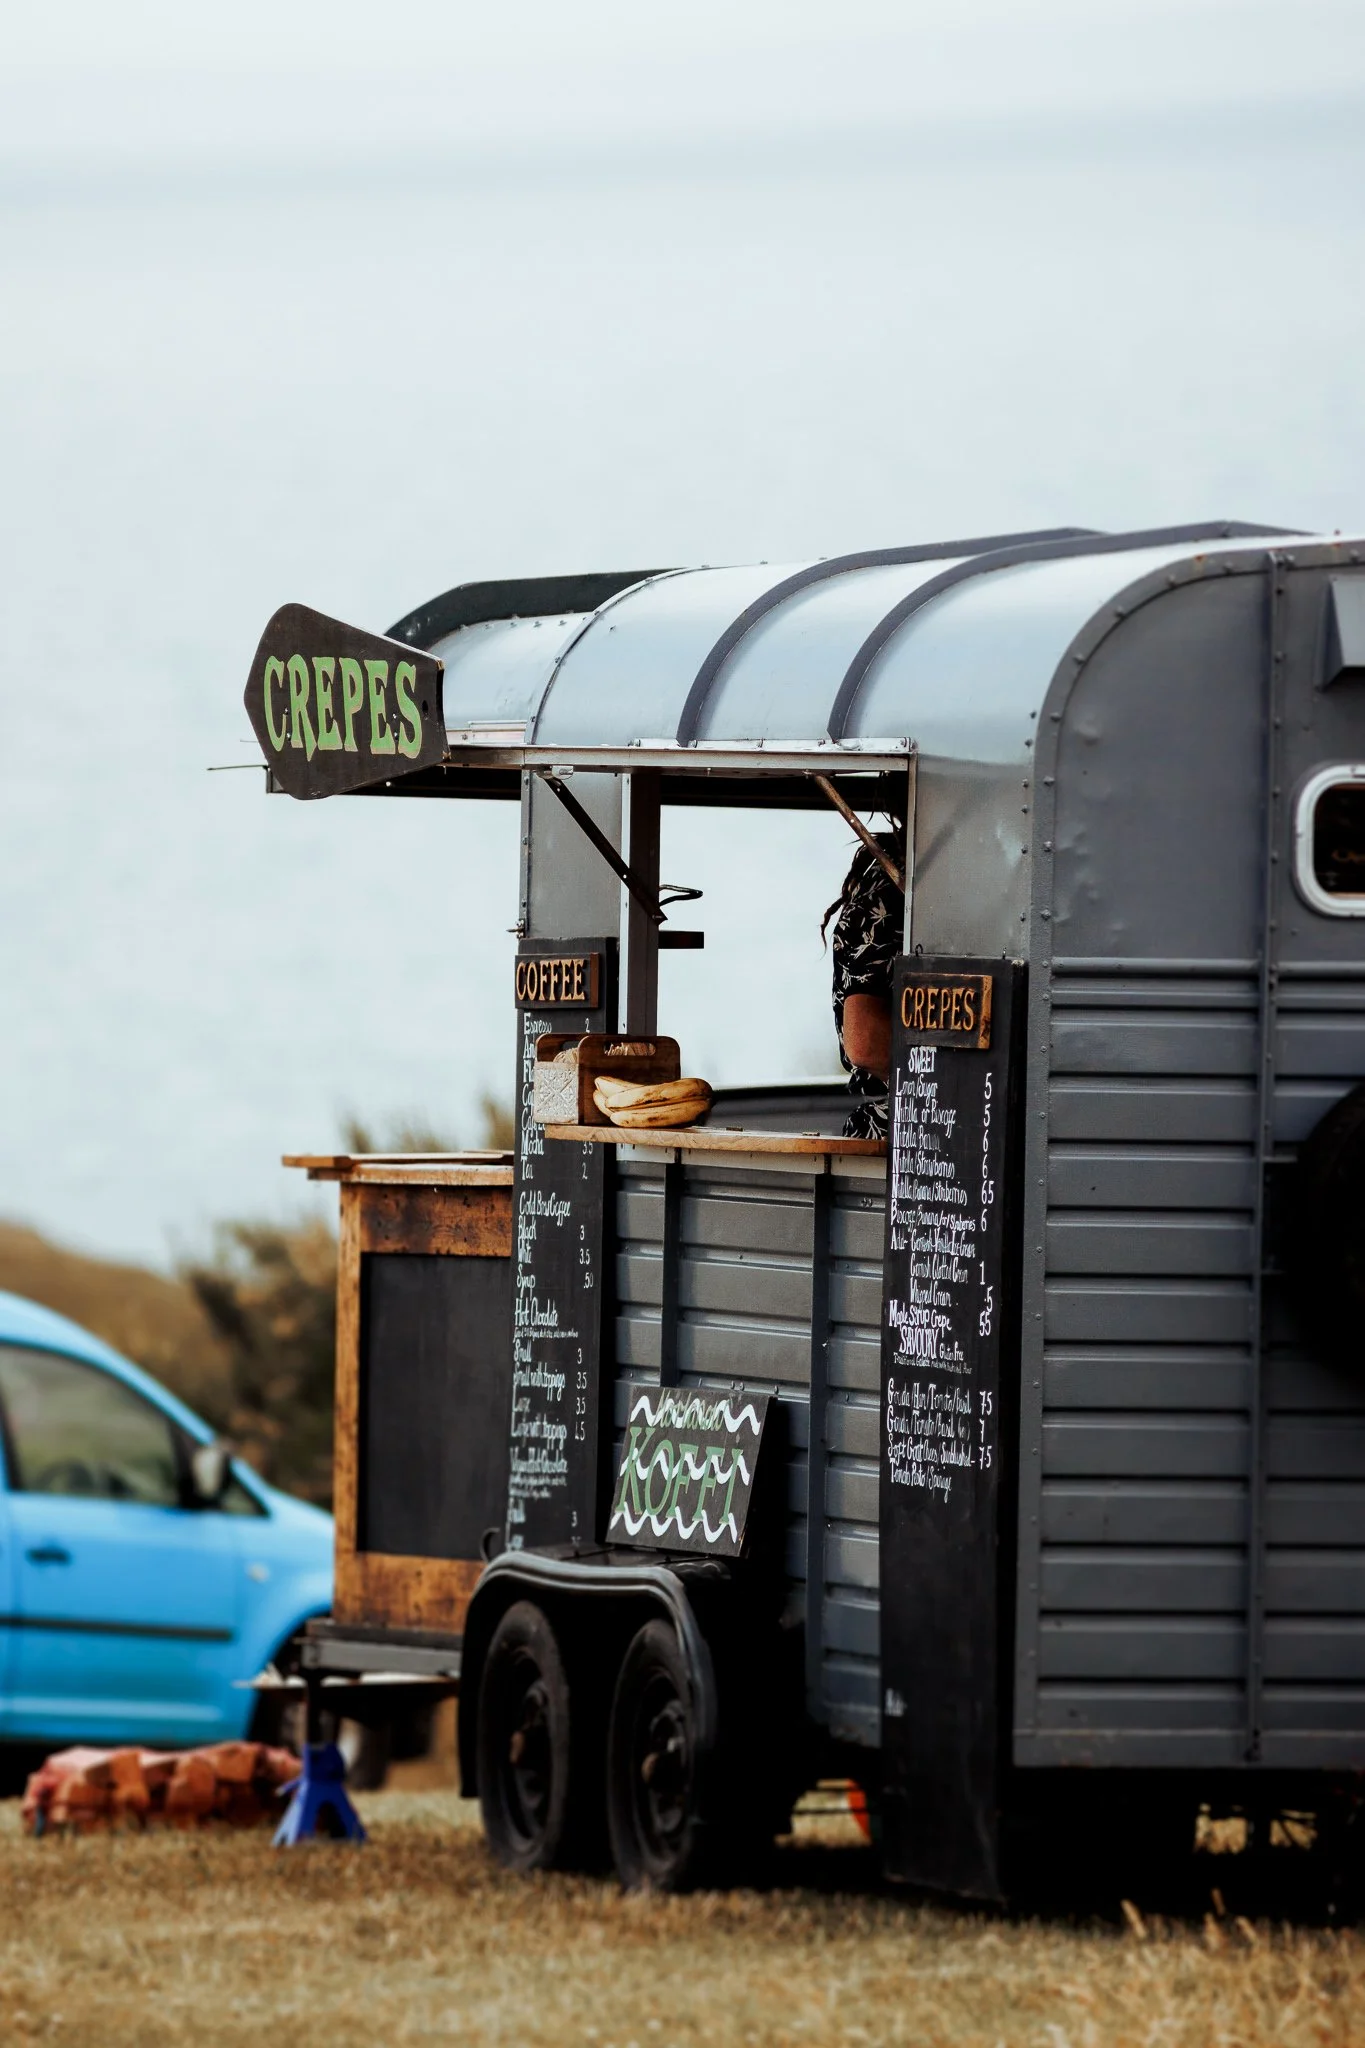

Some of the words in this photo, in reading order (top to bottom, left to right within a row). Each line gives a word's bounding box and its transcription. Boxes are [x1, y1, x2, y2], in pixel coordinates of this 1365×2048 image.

[263, 654, 423, 762] CREPES
[516, 959, 586, 1001] COFFEE
[901, 987, 976, 1031] CREPES
[907, 1046, 937, 1074] SWEET
[984, 1072, 993, 1100] 5
[921, 1109, 931, 1124] or
[983, 1103, 992, 1128] 5
[520, 1129, 545, 1156] Mocha
[982, 1129, 990, 1153] 6
[520, 1155, 534, 1181] Tea
[582, 1162, 588, 1180] 2
[981, 1153, 989, 1179] 6
[519, 1190, 536, 1216] Cold
[549, 1192, 571, 1227] Coffee
[981, 1208, 988, 1232] 6
[518, 1215, 537, 1240] Black
[579, 1224, 585, 1241] 3
[579, 1247, 591, 1265] 3.5
[932, 1253, 952, 1281] Clotted
[979, 1260, 985, 1286] 1
[516, 1263, 536, 1302] Syrup
[932, 1280, 952, 1308] Cream
[514, 1297, 530, 1327] Hot
[888, 1299, 909, 1334] Maple
[931, 1309, 953, 1339] Crepe
[513, 1338, 532, 1363] Small
[576, 1347, 583, 1365] 3
[898, 1324, 940, 1360] SAVOURY
[979, 1418, 985, 1444] 7
[887, 1432, 907, 1467] Soft
[906, 1436, 923, 1463] Goat
[978, 1445, 992, 1470] 7.5
[614, 1426, 744, 1524] KOFFI
